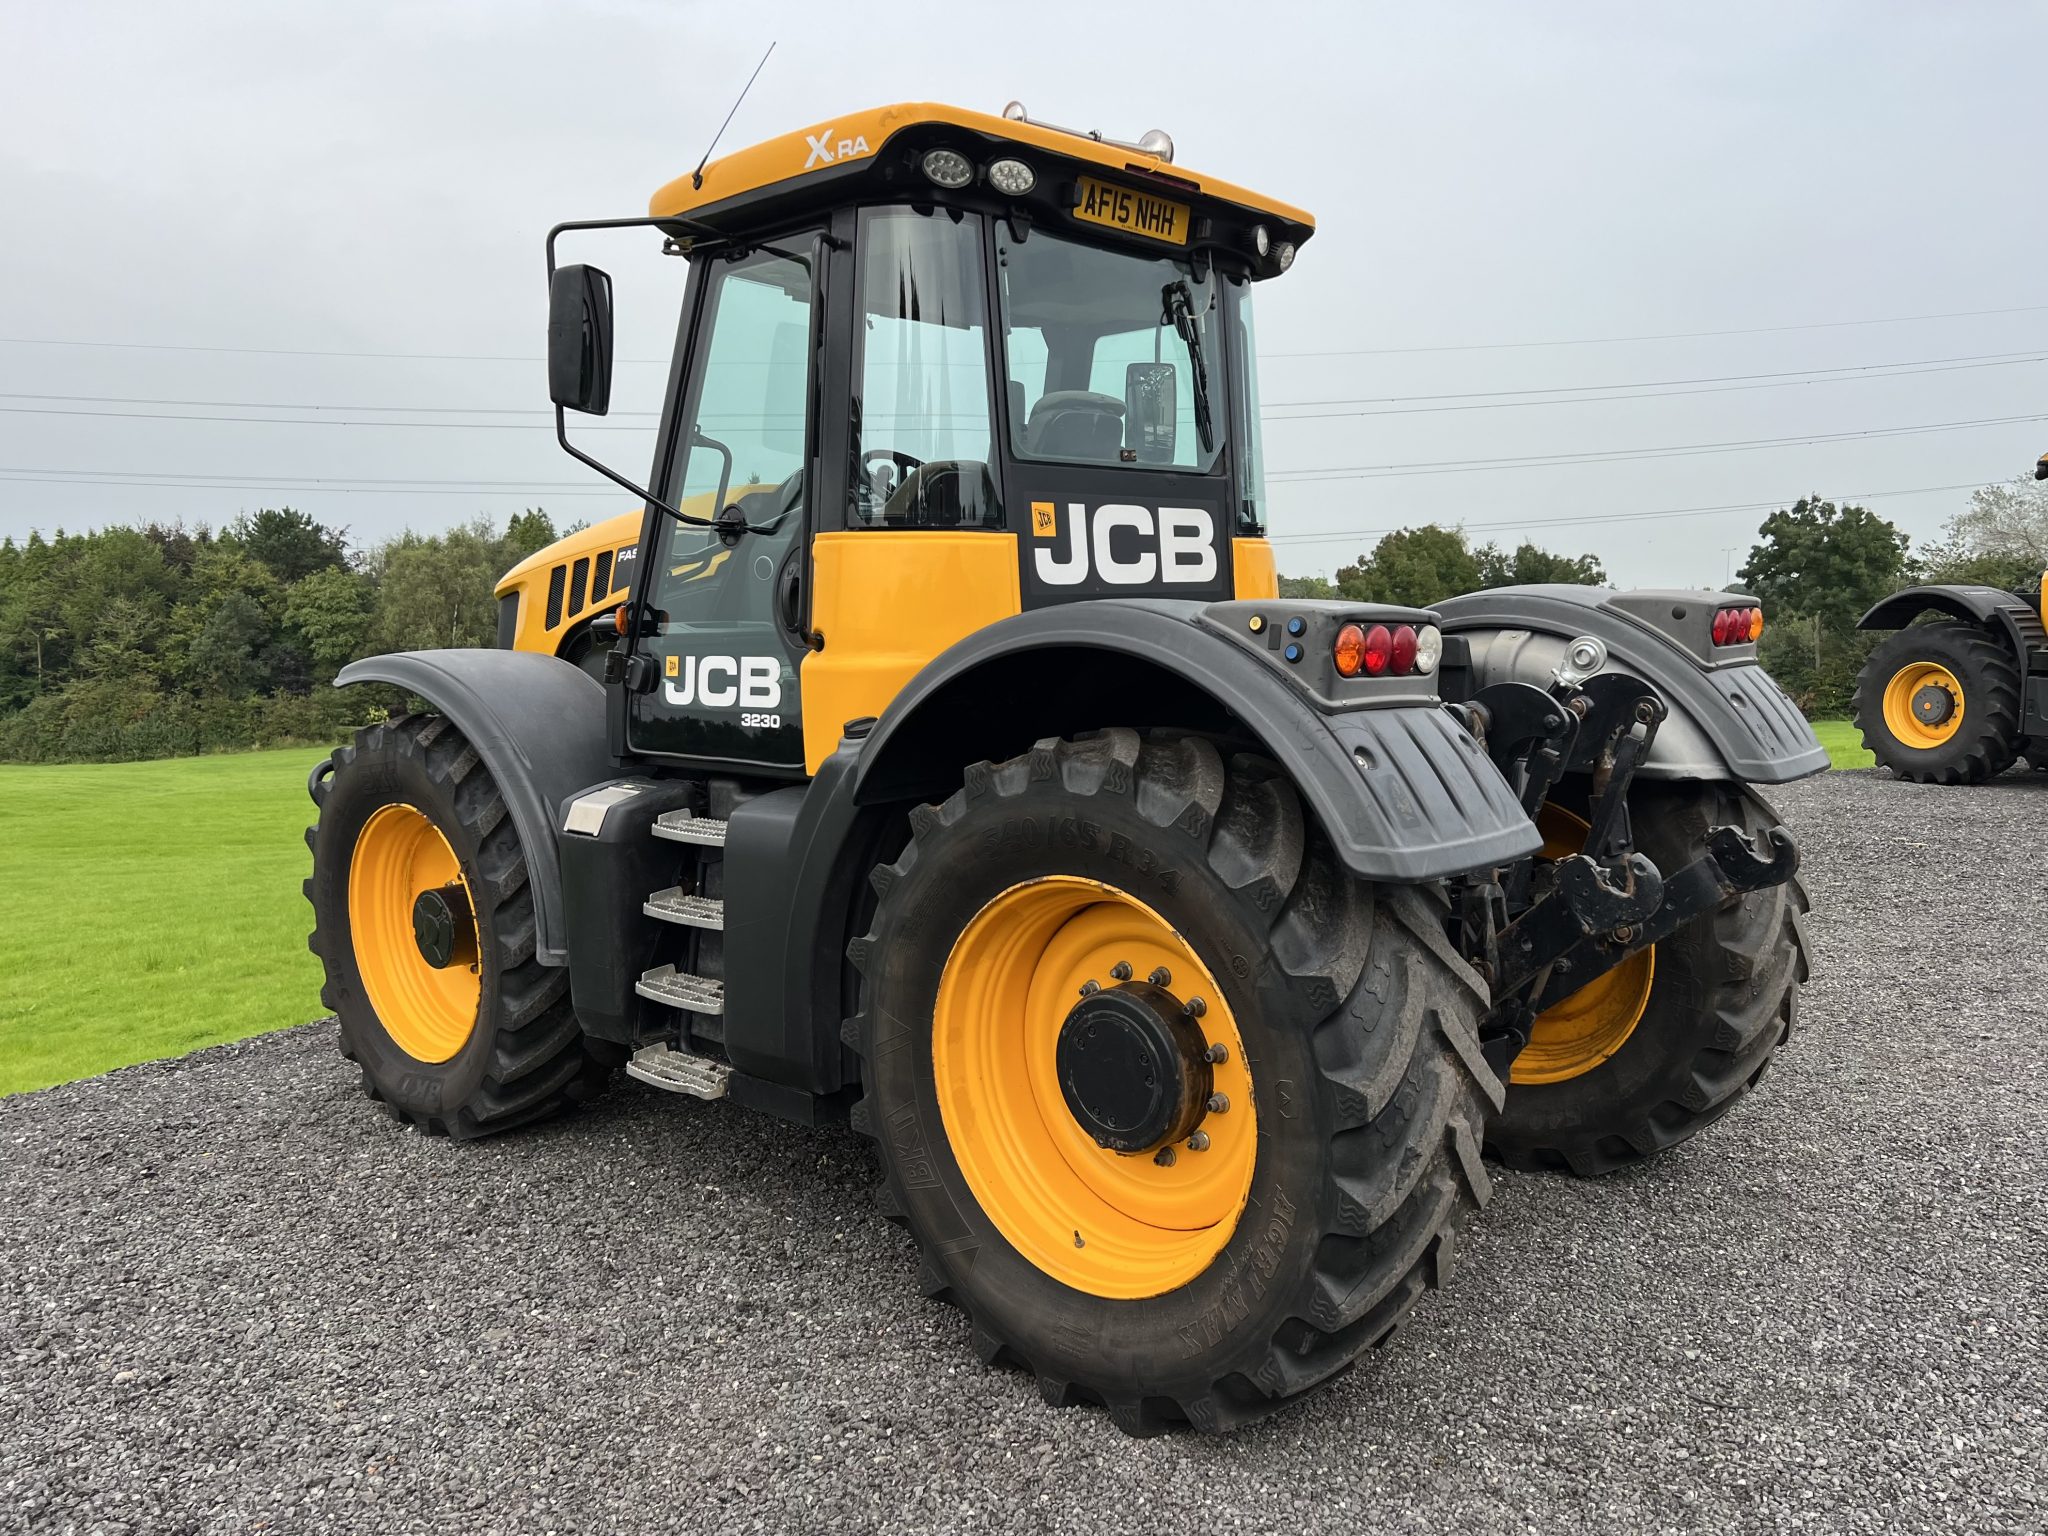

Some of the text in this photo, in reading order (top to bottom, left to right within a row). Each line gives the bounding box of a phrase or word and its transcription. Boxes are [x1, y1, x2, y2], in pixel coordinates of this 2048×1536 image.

[804, 128, 870, 168] XRA
[1084, 184, 1175, 236] AF15 NHH
[1034, 503, 1217, 585] JCB
[664, 656, 781, 708] JCB
[741, 713, 780, 728] 3230
[893, 1113, 935, 1184] BKT
